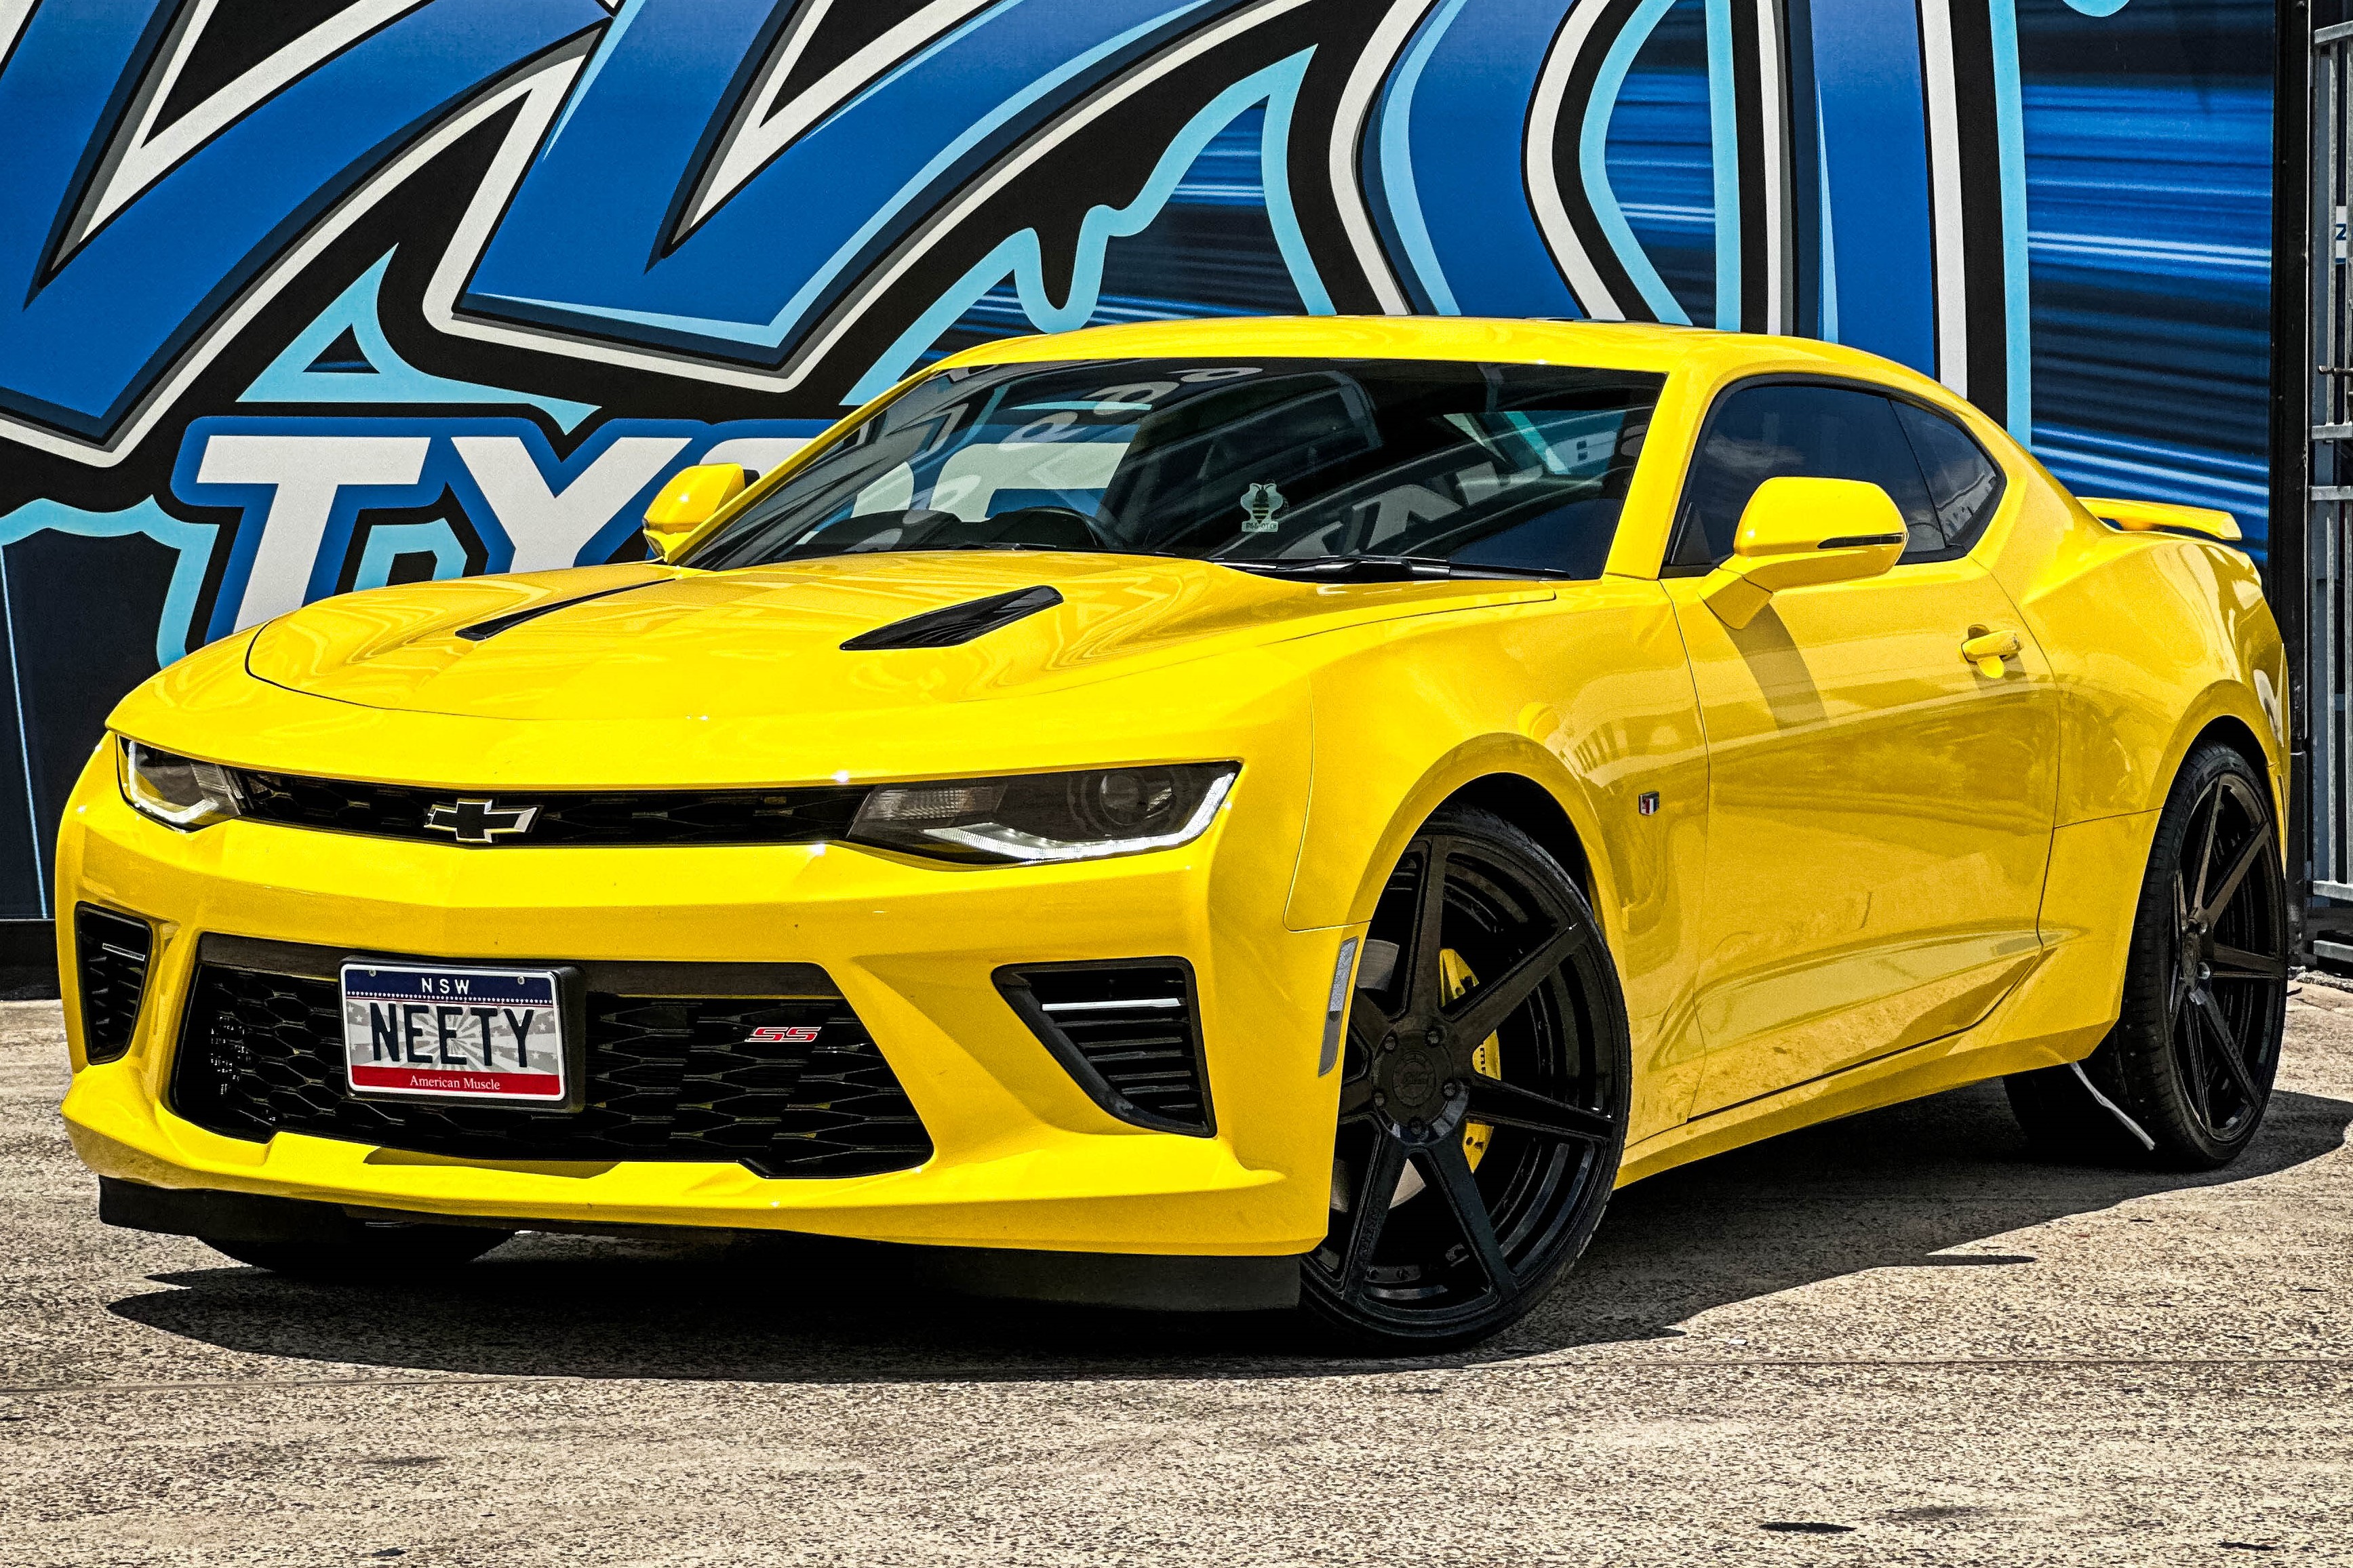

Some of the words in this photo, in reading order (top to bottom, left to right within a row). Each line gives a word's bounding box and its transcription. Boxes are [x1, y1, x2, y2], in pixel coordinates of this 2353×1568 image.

[421, 978, 470, 994] NSW
[370, 1002, 534, 1068] NEETY
[744, 1026, 822, 1043] SS
[410, 1074, 460, 1089] American
[463, 1077, 501, 1090] Muscle
